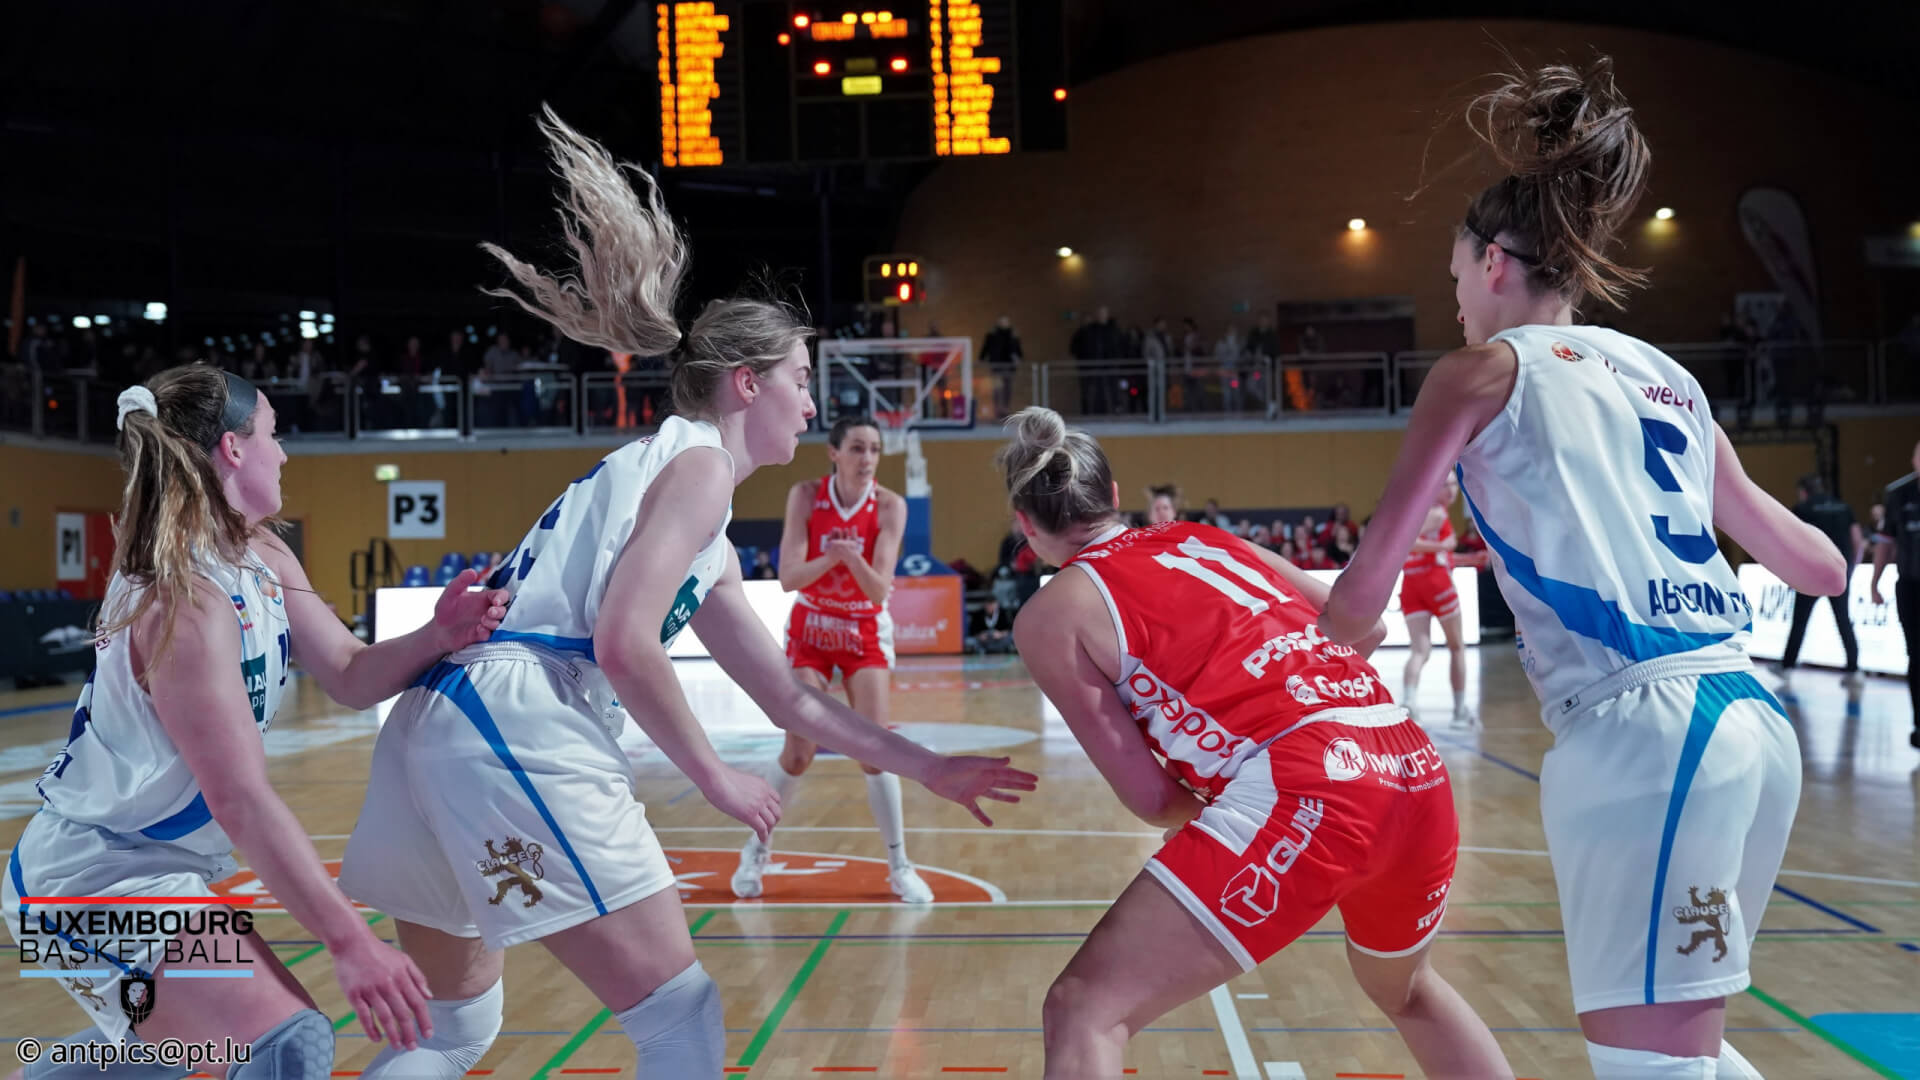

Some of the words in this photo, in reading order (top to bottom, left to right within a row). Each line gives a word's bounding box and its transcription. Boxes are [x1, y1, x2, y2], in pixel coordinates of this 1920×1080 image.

[394, 495, 439, 524] P3
[62, 528, 83, 564] P1
[1152, 535, 1293, 616] 11
[1266, 796, 1324, 874] QUBE
